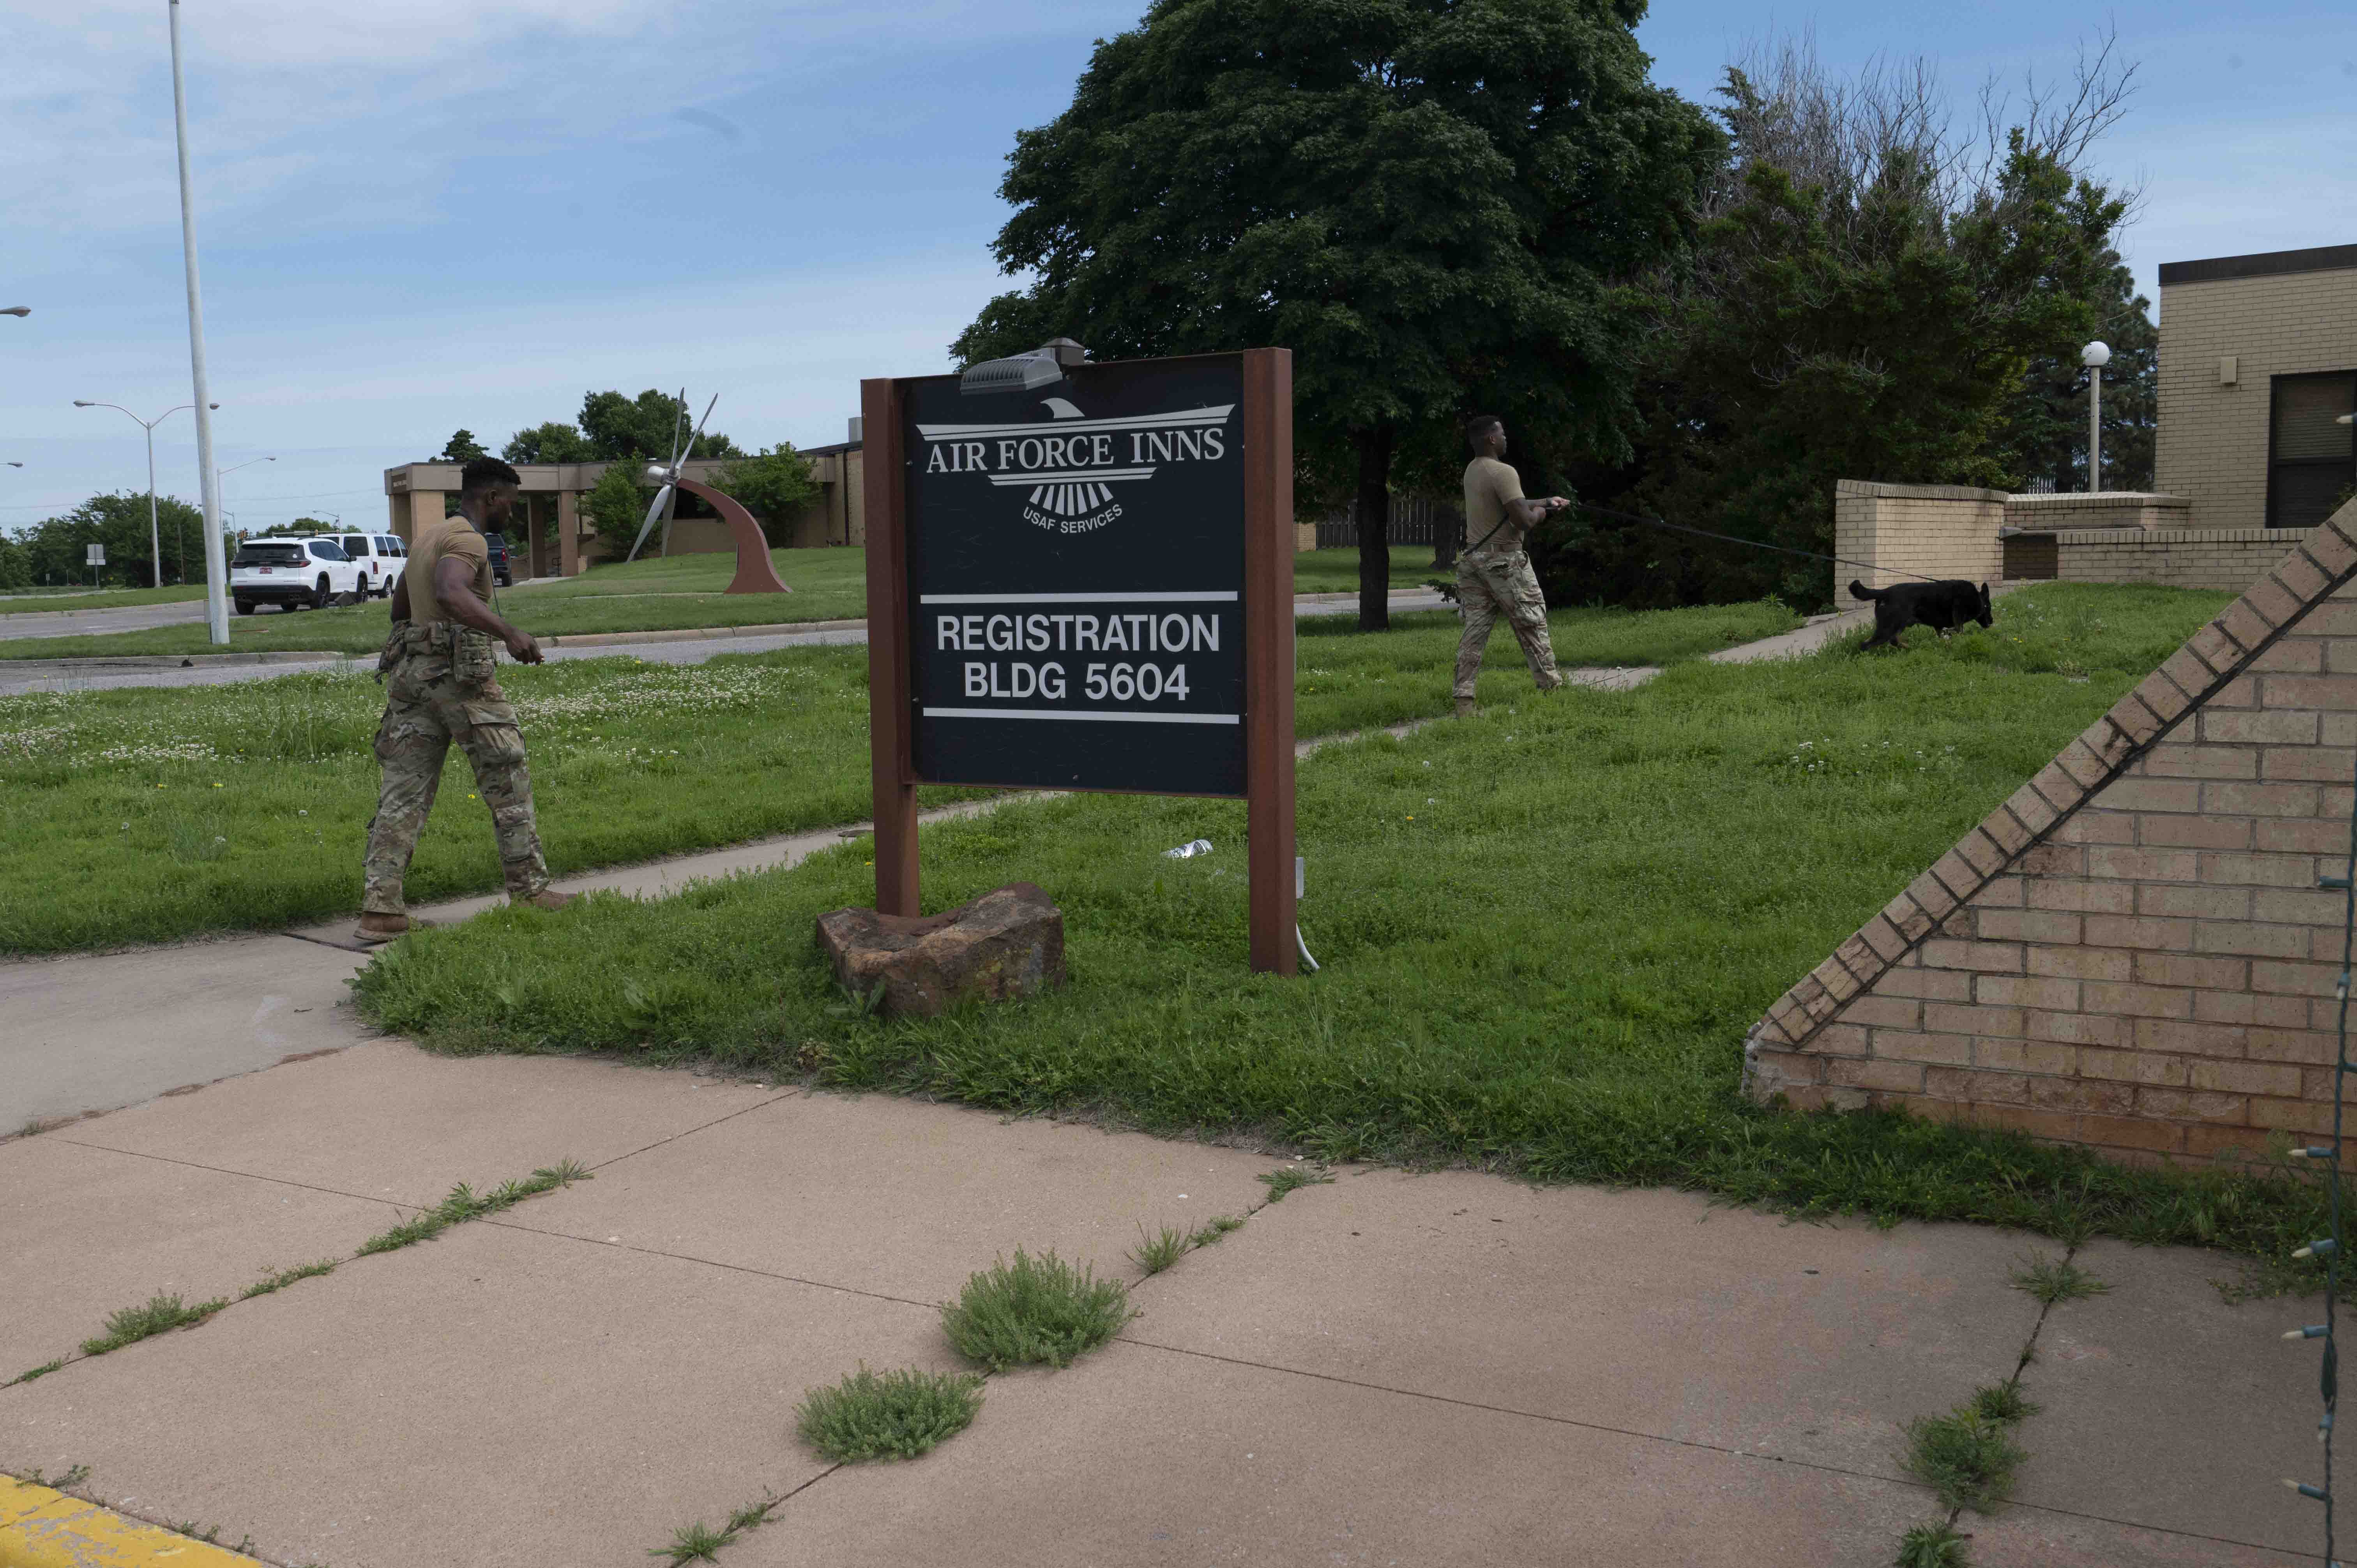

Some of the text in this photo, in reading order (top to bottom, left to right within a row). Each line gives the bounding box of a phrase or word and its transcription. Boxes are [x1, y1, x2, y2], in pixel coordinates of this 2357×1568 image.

[926, 427, 1224, 473] AIR FORCE INNS
[1023, 504, 1122, 533] USAF SERVICES
[937, 613, 1219, 652] REGISTRATION
[965, 662, 1190, 701] BLDG 5604
